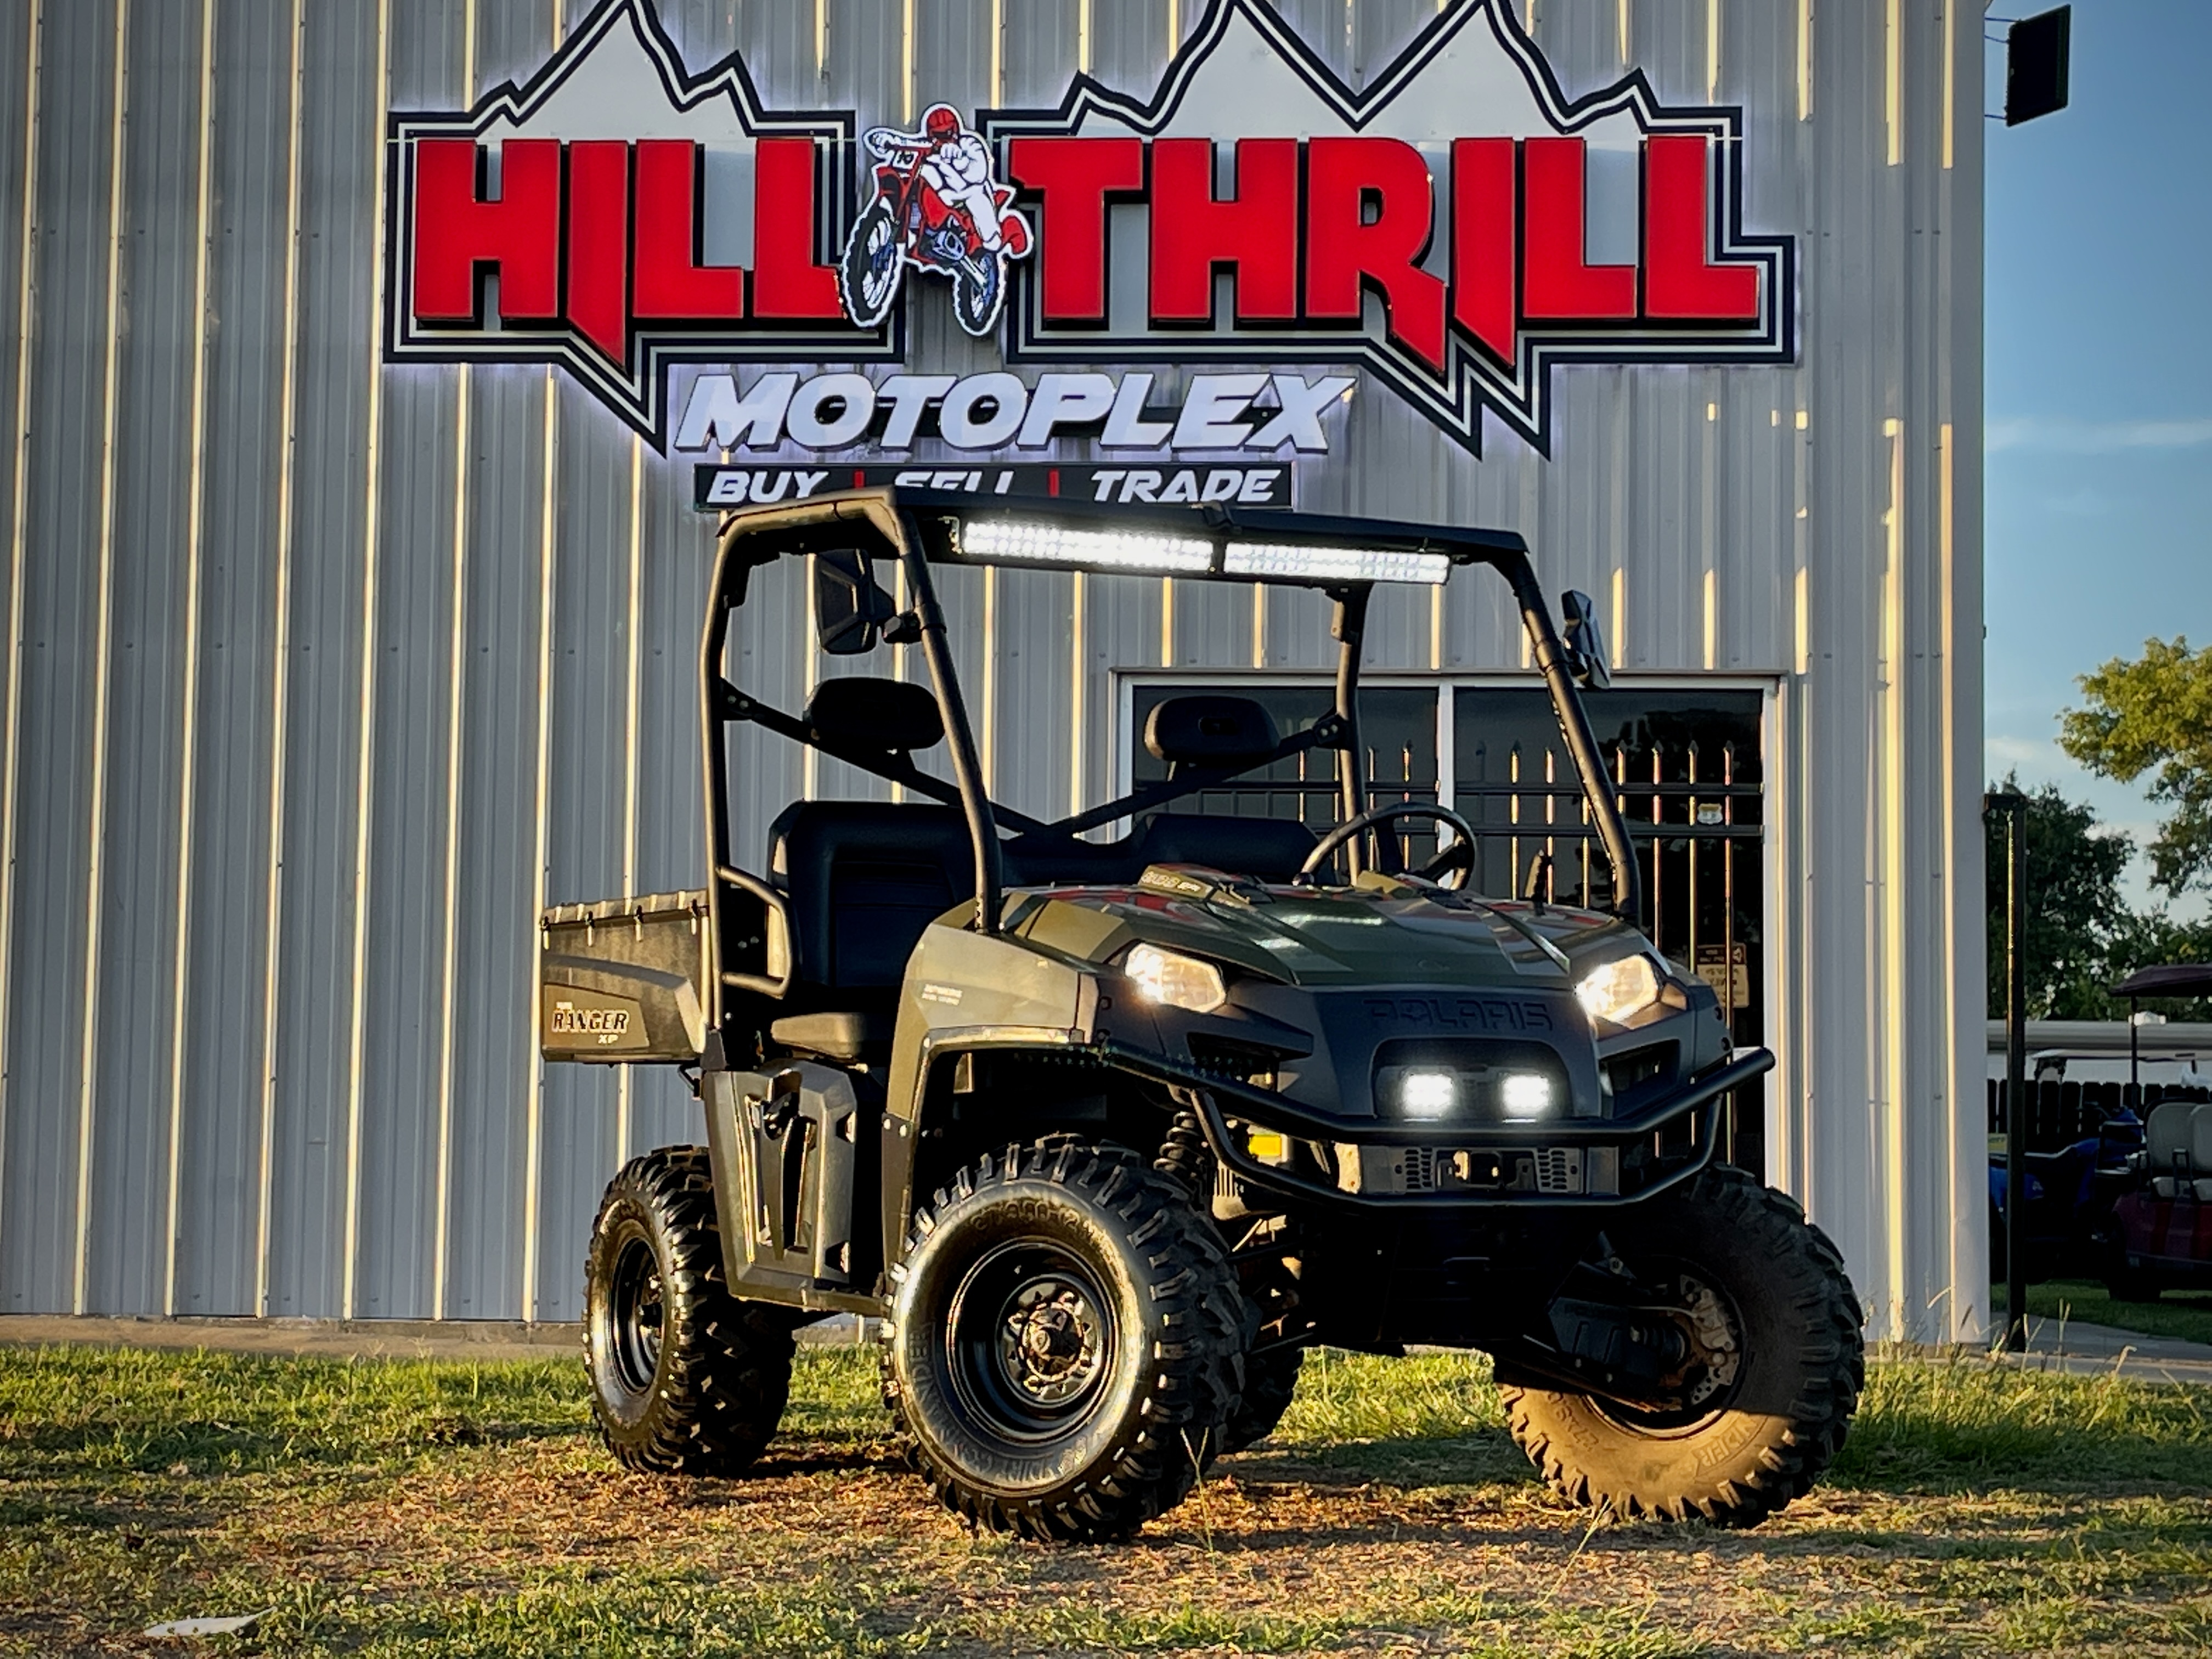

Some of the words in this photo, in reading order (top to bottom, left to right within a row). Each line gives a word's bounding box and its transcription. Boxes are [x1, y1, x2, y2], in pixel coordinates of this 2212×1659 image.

[415, 139, 848, 367] HILL
[1010, 136, 1758, 374] THRILL
[674, 372, 1357, 454] MOTOPLEX
[707, 471, 829, 503] BUY
[1091, 470, 1282, 503] TRADE
[551, 1009, 630, 1034] RANGER
[1363, 998, 1553, 1031] POLARIS
[598, 1034, 619, 1044] XP
